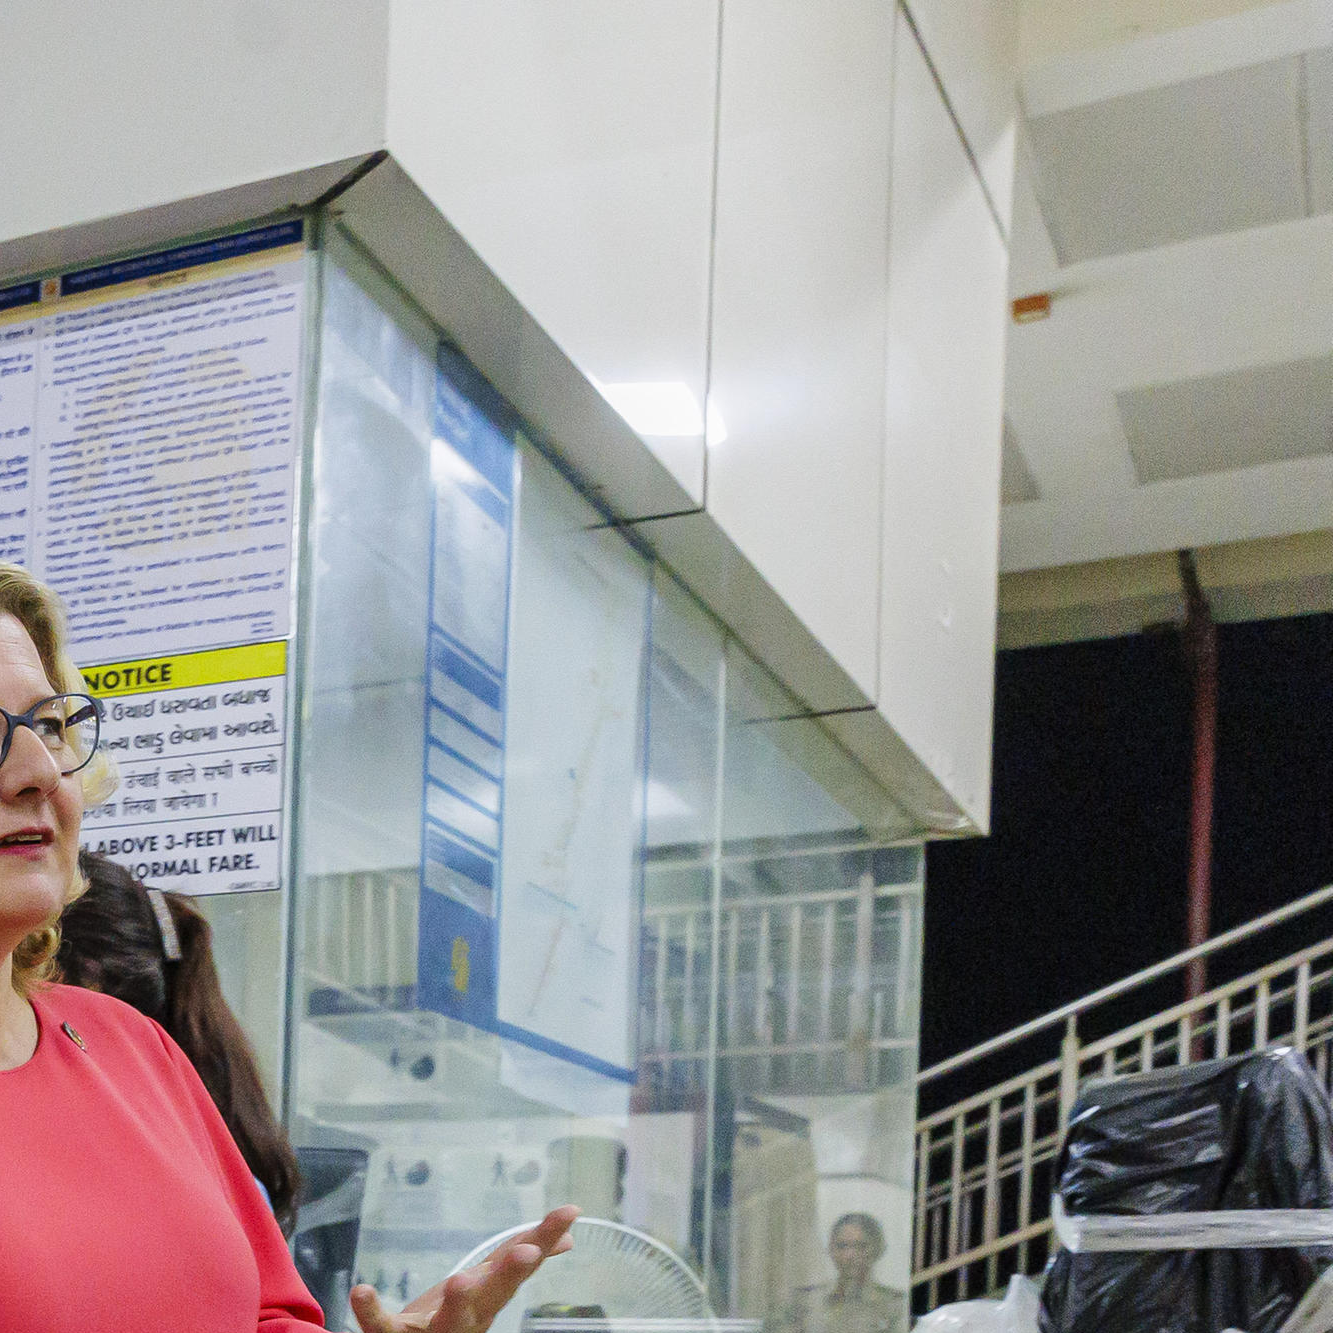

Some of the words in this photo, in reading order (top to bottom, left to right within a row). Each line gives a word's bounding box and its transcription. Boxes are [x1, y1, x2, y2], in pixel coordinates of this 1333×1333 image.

[84, 663, 173, 691] NOTICE
[97, 835, 159, 856] ABOVE
[164, 828, 227, 851] 3-FEET
[232, 823, 278, 845] WILL
[131, 857, 202, 879] ORMAL
